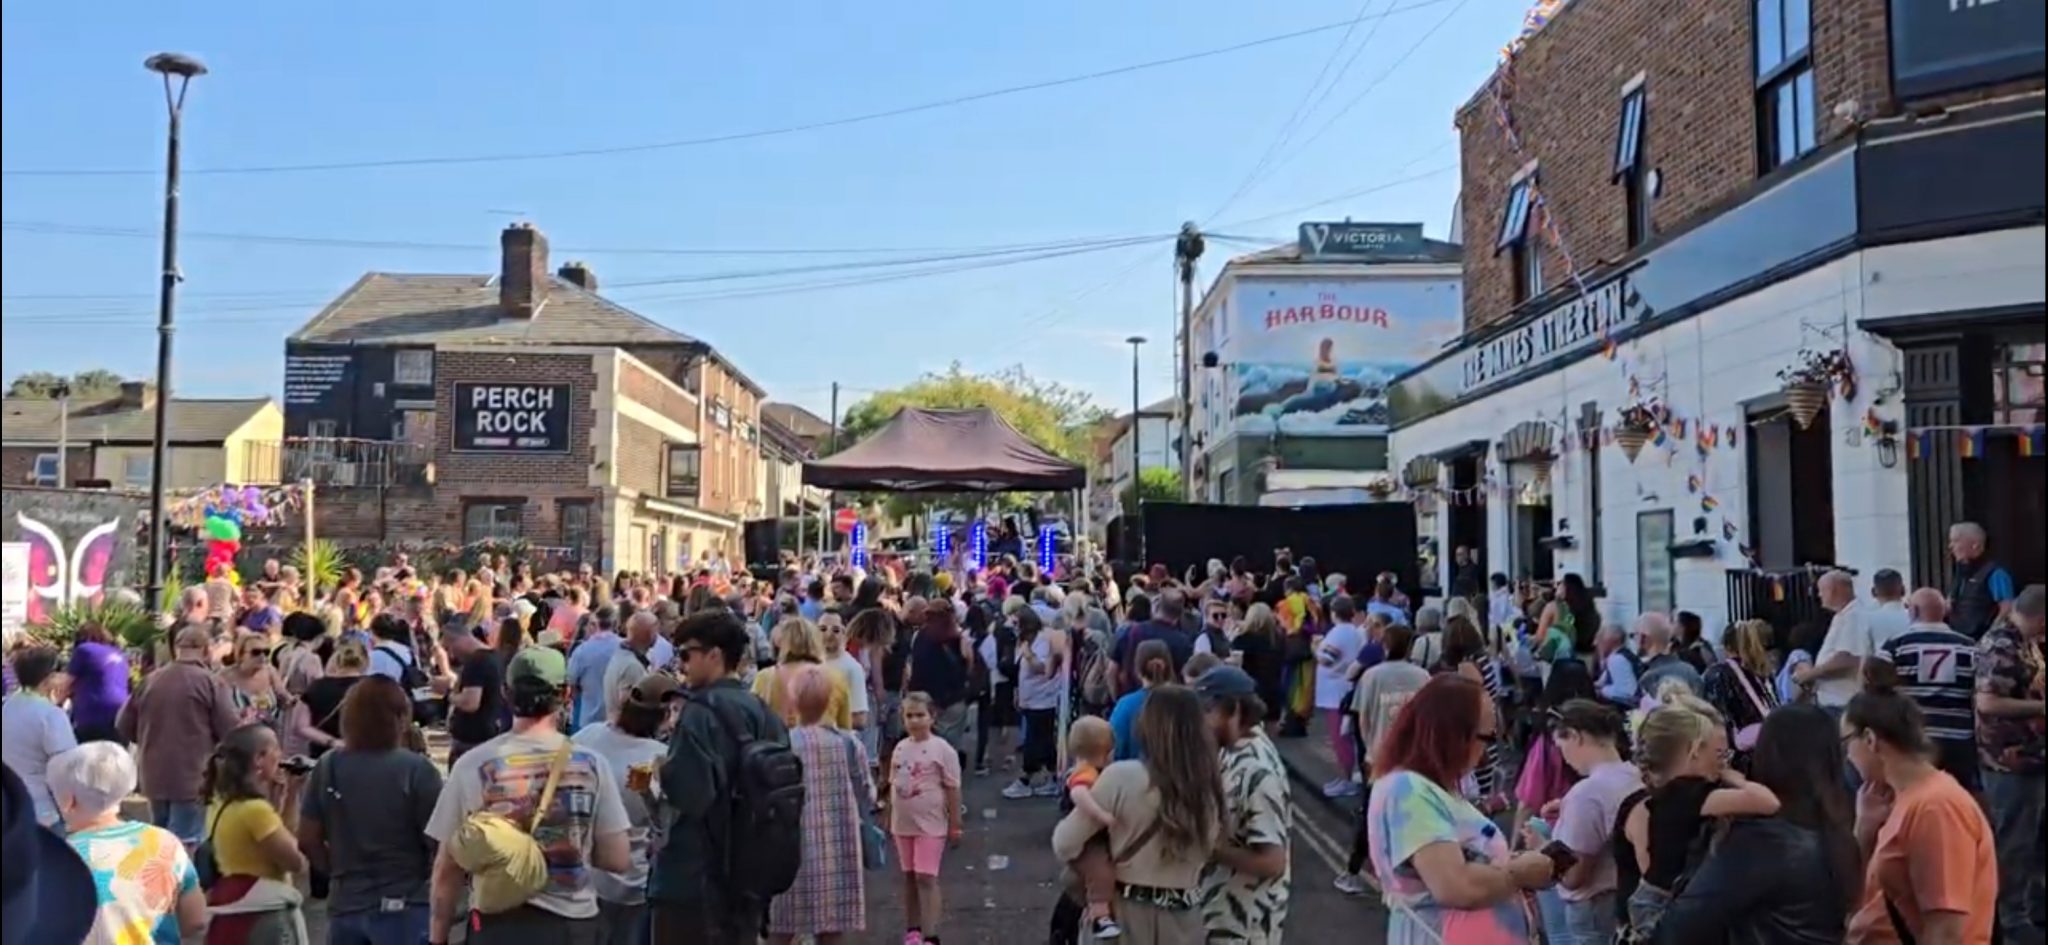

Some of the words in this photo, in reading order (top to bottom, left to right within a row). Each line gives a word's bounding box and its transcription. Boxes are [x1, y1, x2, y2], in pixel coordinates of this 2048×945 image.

[1333, 233, 1403, 244] VICTORIA
[1265, 303, 1389, 329] HARBOUR
[472, 387, 554, 409] PERCH
[476, 411, 546, 433] ROCK
[1921, 649, 1952, 680] 7
